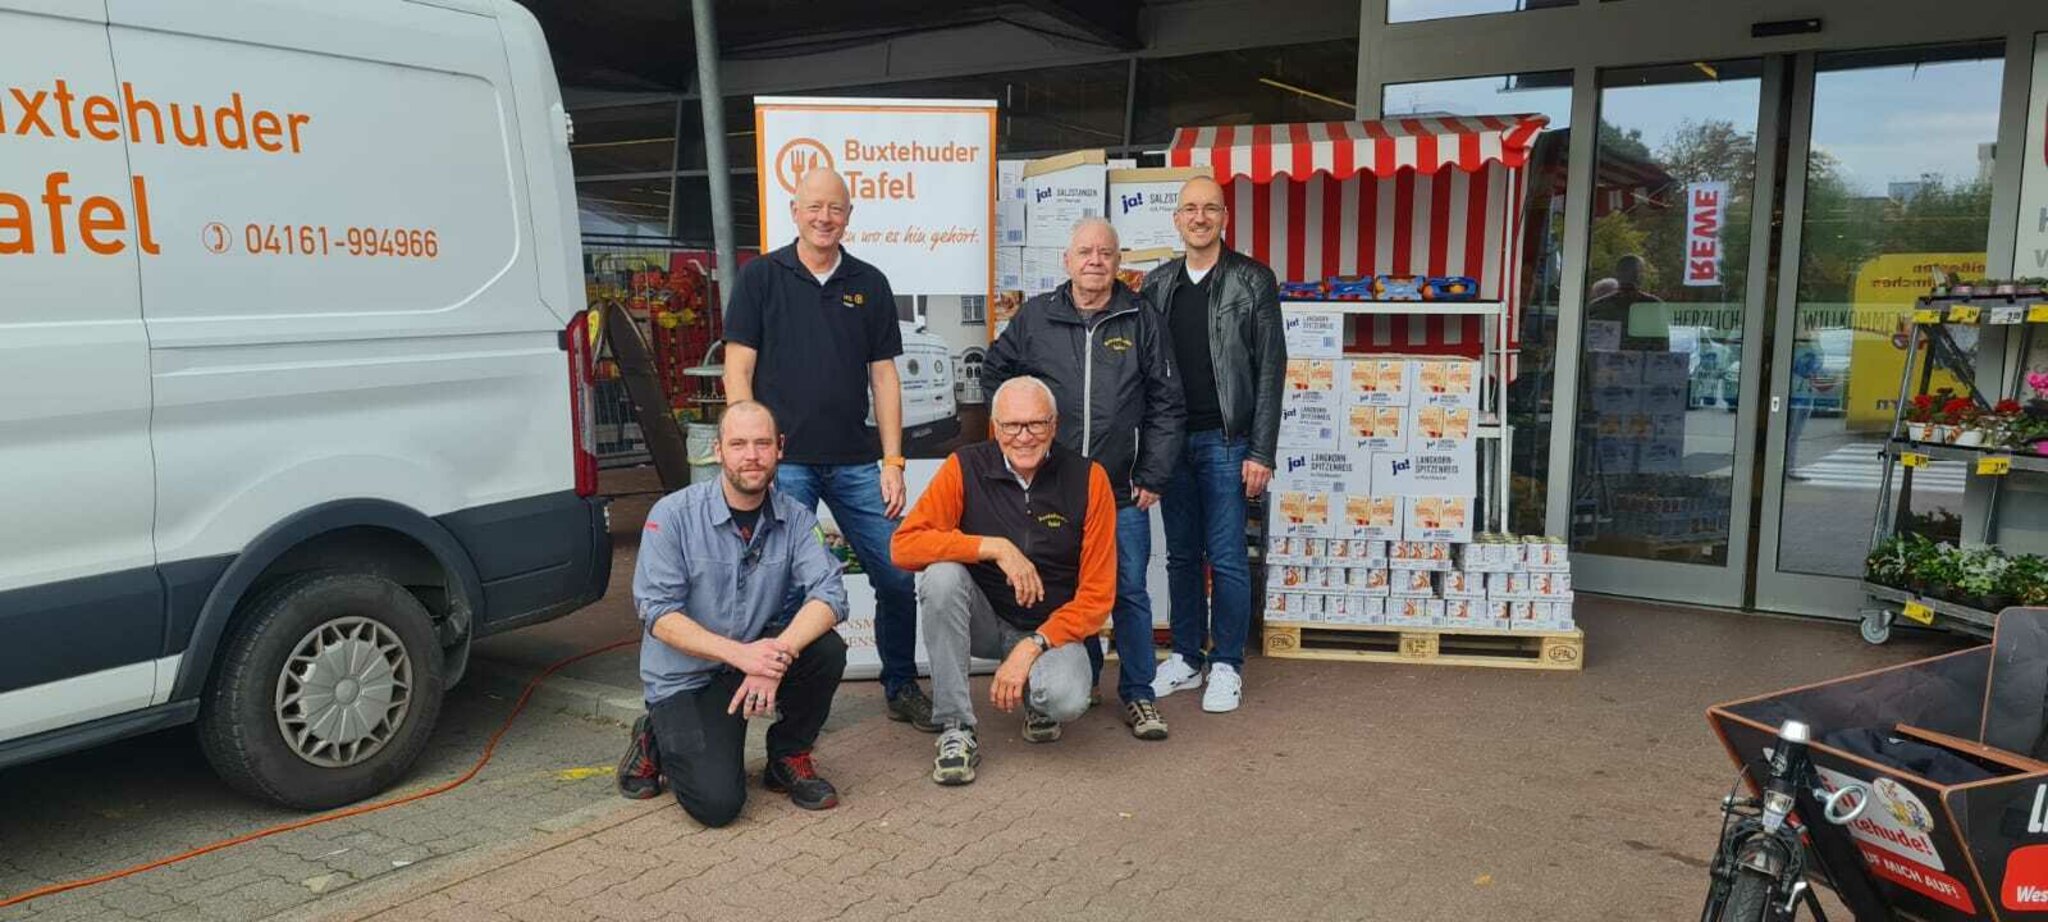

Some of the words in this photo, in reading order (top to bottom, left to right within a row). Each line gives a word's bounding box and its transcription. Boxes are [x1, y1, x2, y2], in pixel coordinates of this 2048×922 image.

[845, 140, 979, 162] Buxtehuder
[844, 171, 915, 199] Tafel
[1121, 191, 1144, 215] ja!
[244, 223, 439, 257] 04161-994966
[1673, 309, 1739, 330] HERZLICH
[1288, 455, 1305, 472] ja!
[1392, 459, 1411, 476] ja!
[1850, 817, 1933, 856] tehude!
[1884, 859, 1922, 884] MICH
[1925, 875, 1960, 899] AUF!
